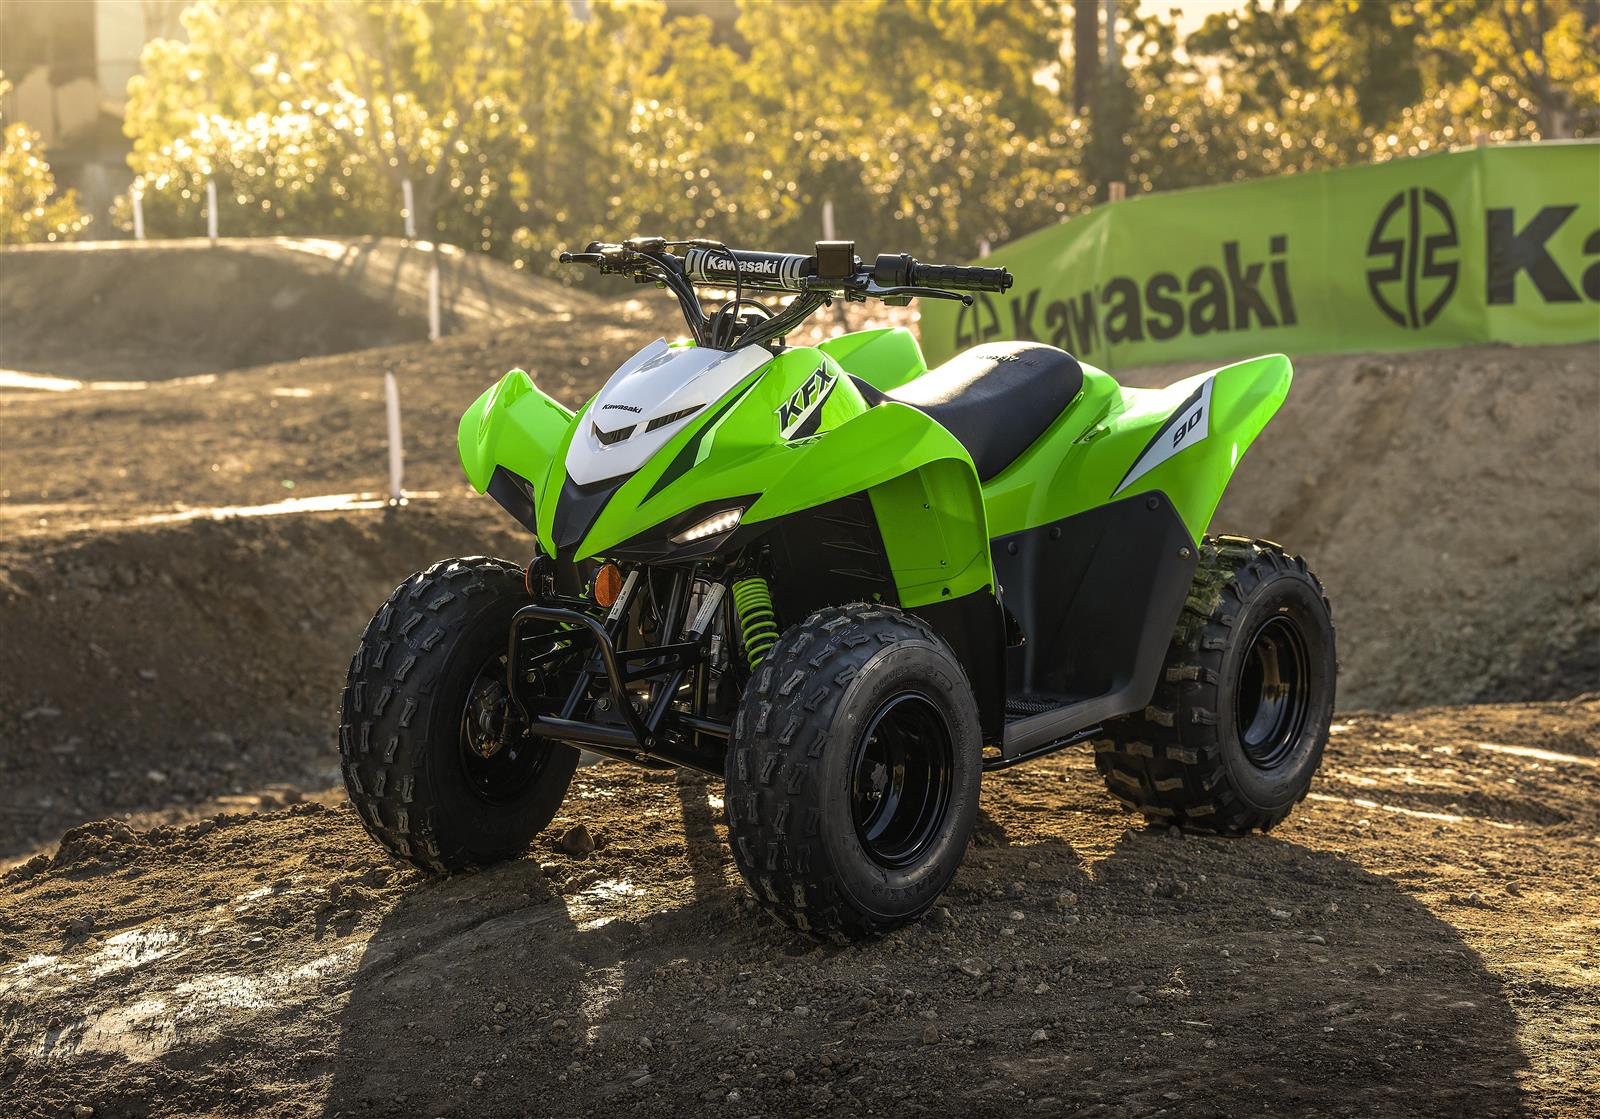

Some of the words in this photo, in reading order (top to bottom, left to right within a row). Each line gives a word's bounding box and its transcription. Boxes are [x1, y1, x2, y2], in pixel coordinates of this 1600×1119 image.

[706, 255, 778, 274] Kawasaki
[1010, 234, 1298, 356] Kawasaki
[602, 403, 643, 414] Kawasaki
[778, 360, 833, 433] KFX
[1173, 406, 1203, 448] 90
